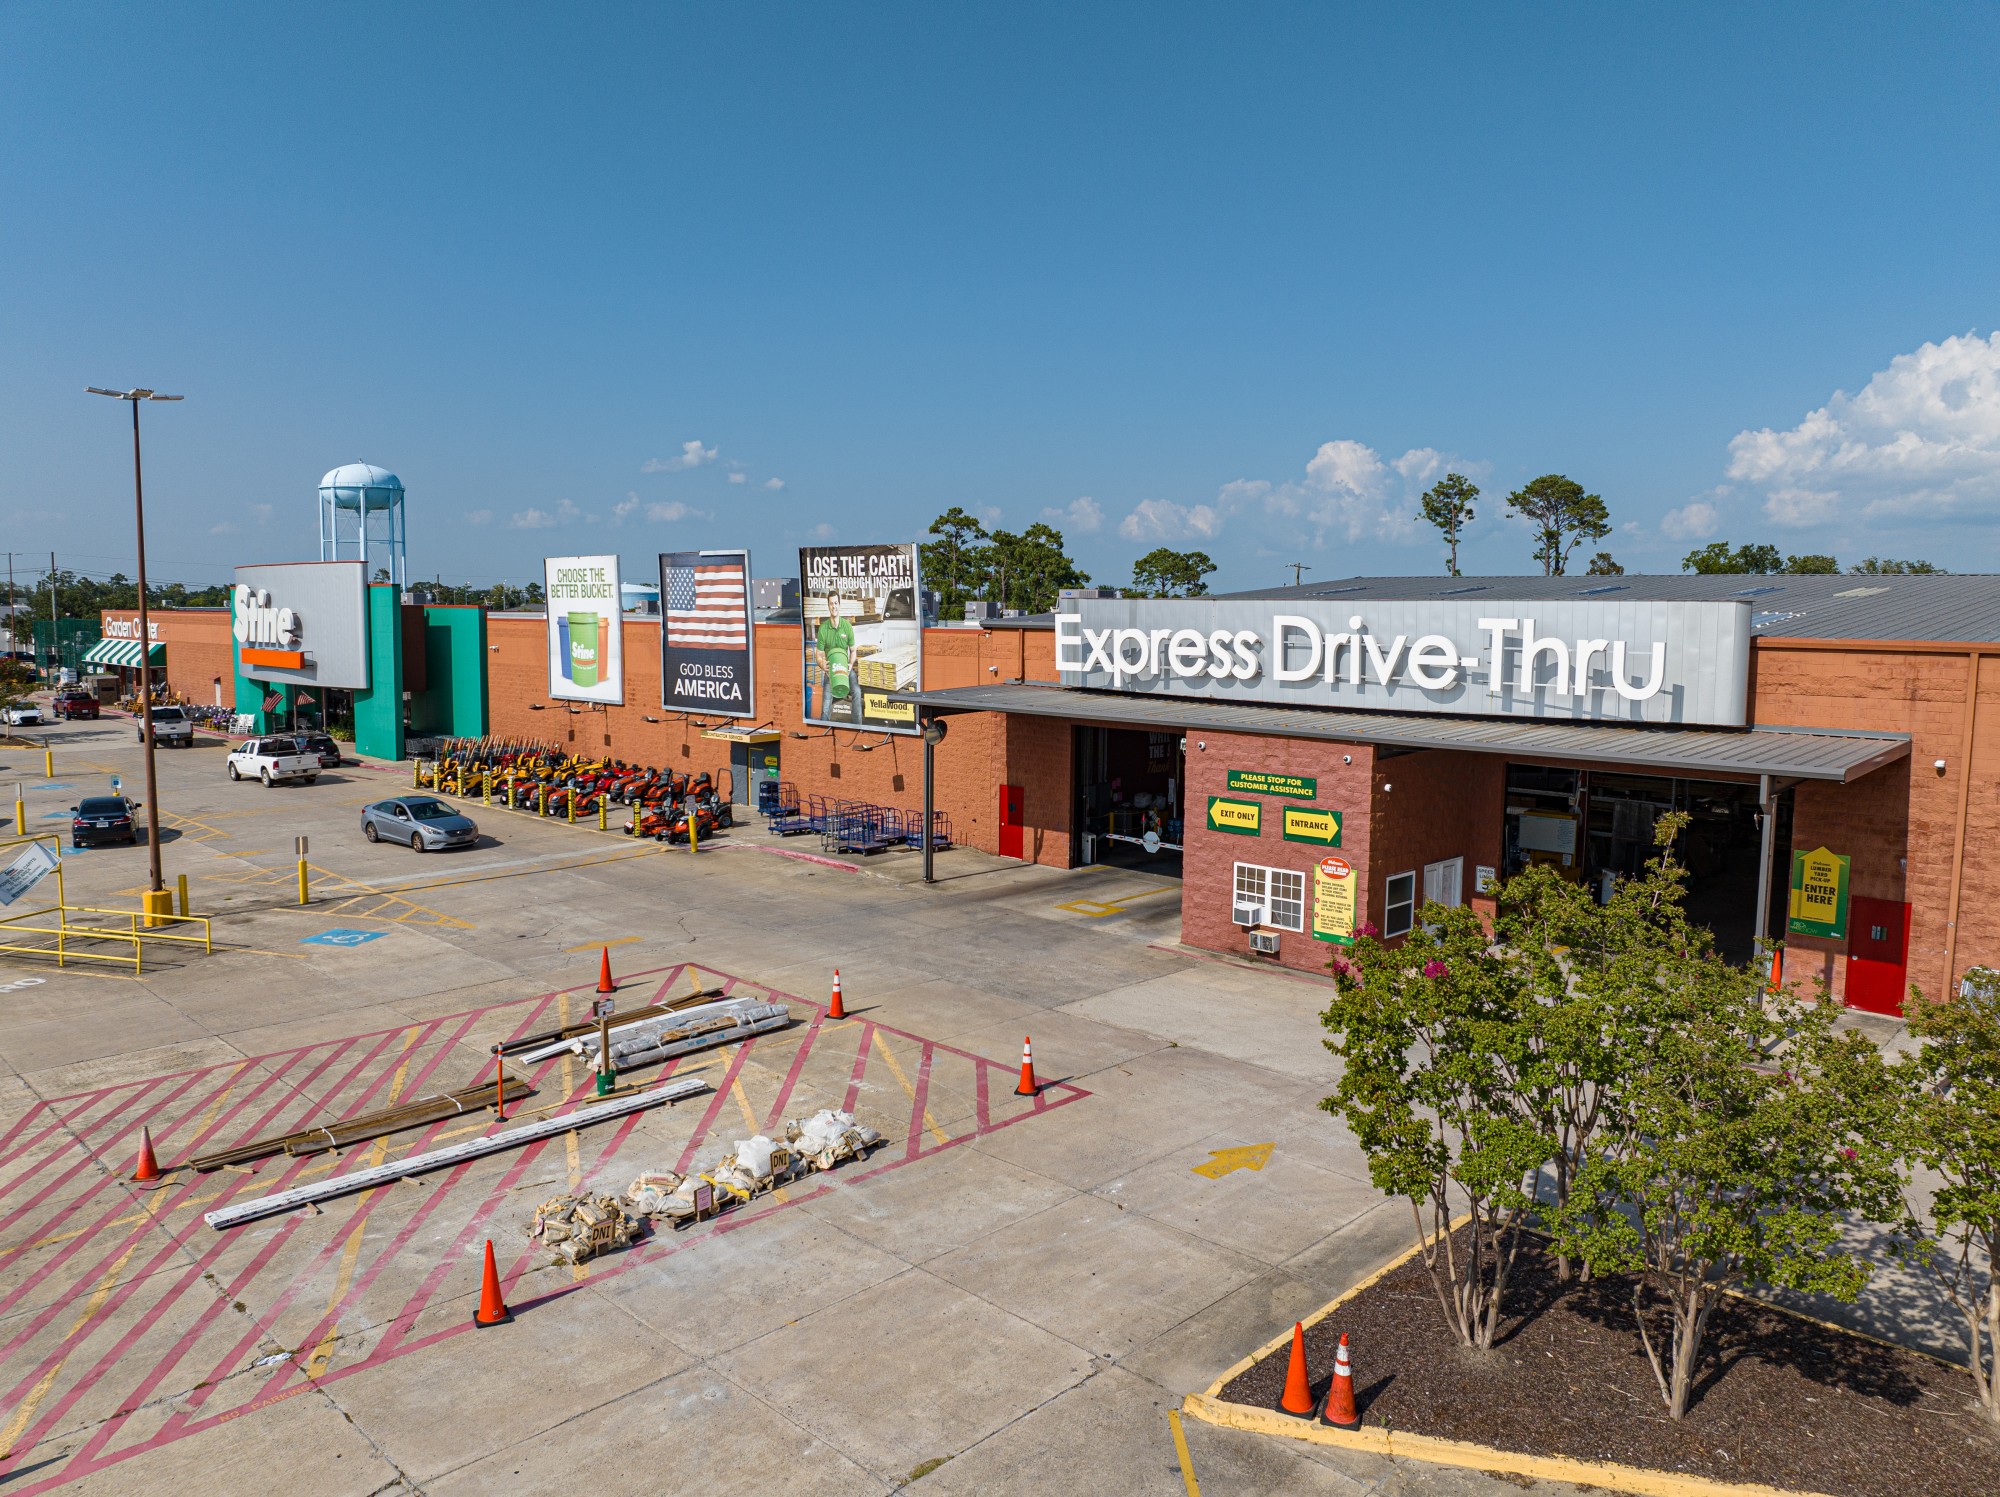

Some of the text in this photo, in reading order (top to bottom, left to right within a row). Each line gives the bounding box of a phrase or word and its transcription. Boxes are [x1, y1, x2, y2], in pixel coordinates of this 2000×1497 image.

[806, 554, 910, 576] LOSE THE CART!
[557, 568, 605, 582] CHOOSE THE
[808, 576, 911, 589] DRIVE THROUGH INSTEAD
[551, 584, 614, 598] BETTER BUCKET.
[233, 584, 294, 645] Stine
[106, 616, 160, 640] Garden Cter
[572, 641, 594, 659] Stine
[1054, 613, 1666, 700] Express Drive-Thru
[680, 663, 734, 678] GOD BLESS
[674, 678, 742, 700] AMERICA
[1240, 774, 1302, 786] PLEASE STOP FOR
[1230, 781, 1312, 796] CUSTOMER ASSISTANCE
[1220, 810, 1255, 820] EXIT ONLY
[1291, 819, 1328, 830] ENTRANCE
[1804, 884, 1836, 896] ENTER
[1806, 894, 1833, 905] HERE
[846, 1131, 859, 1145] DNI
[773, 1152, 788, 1168] DNI
[592, 1225, 611, 1241] DNI
